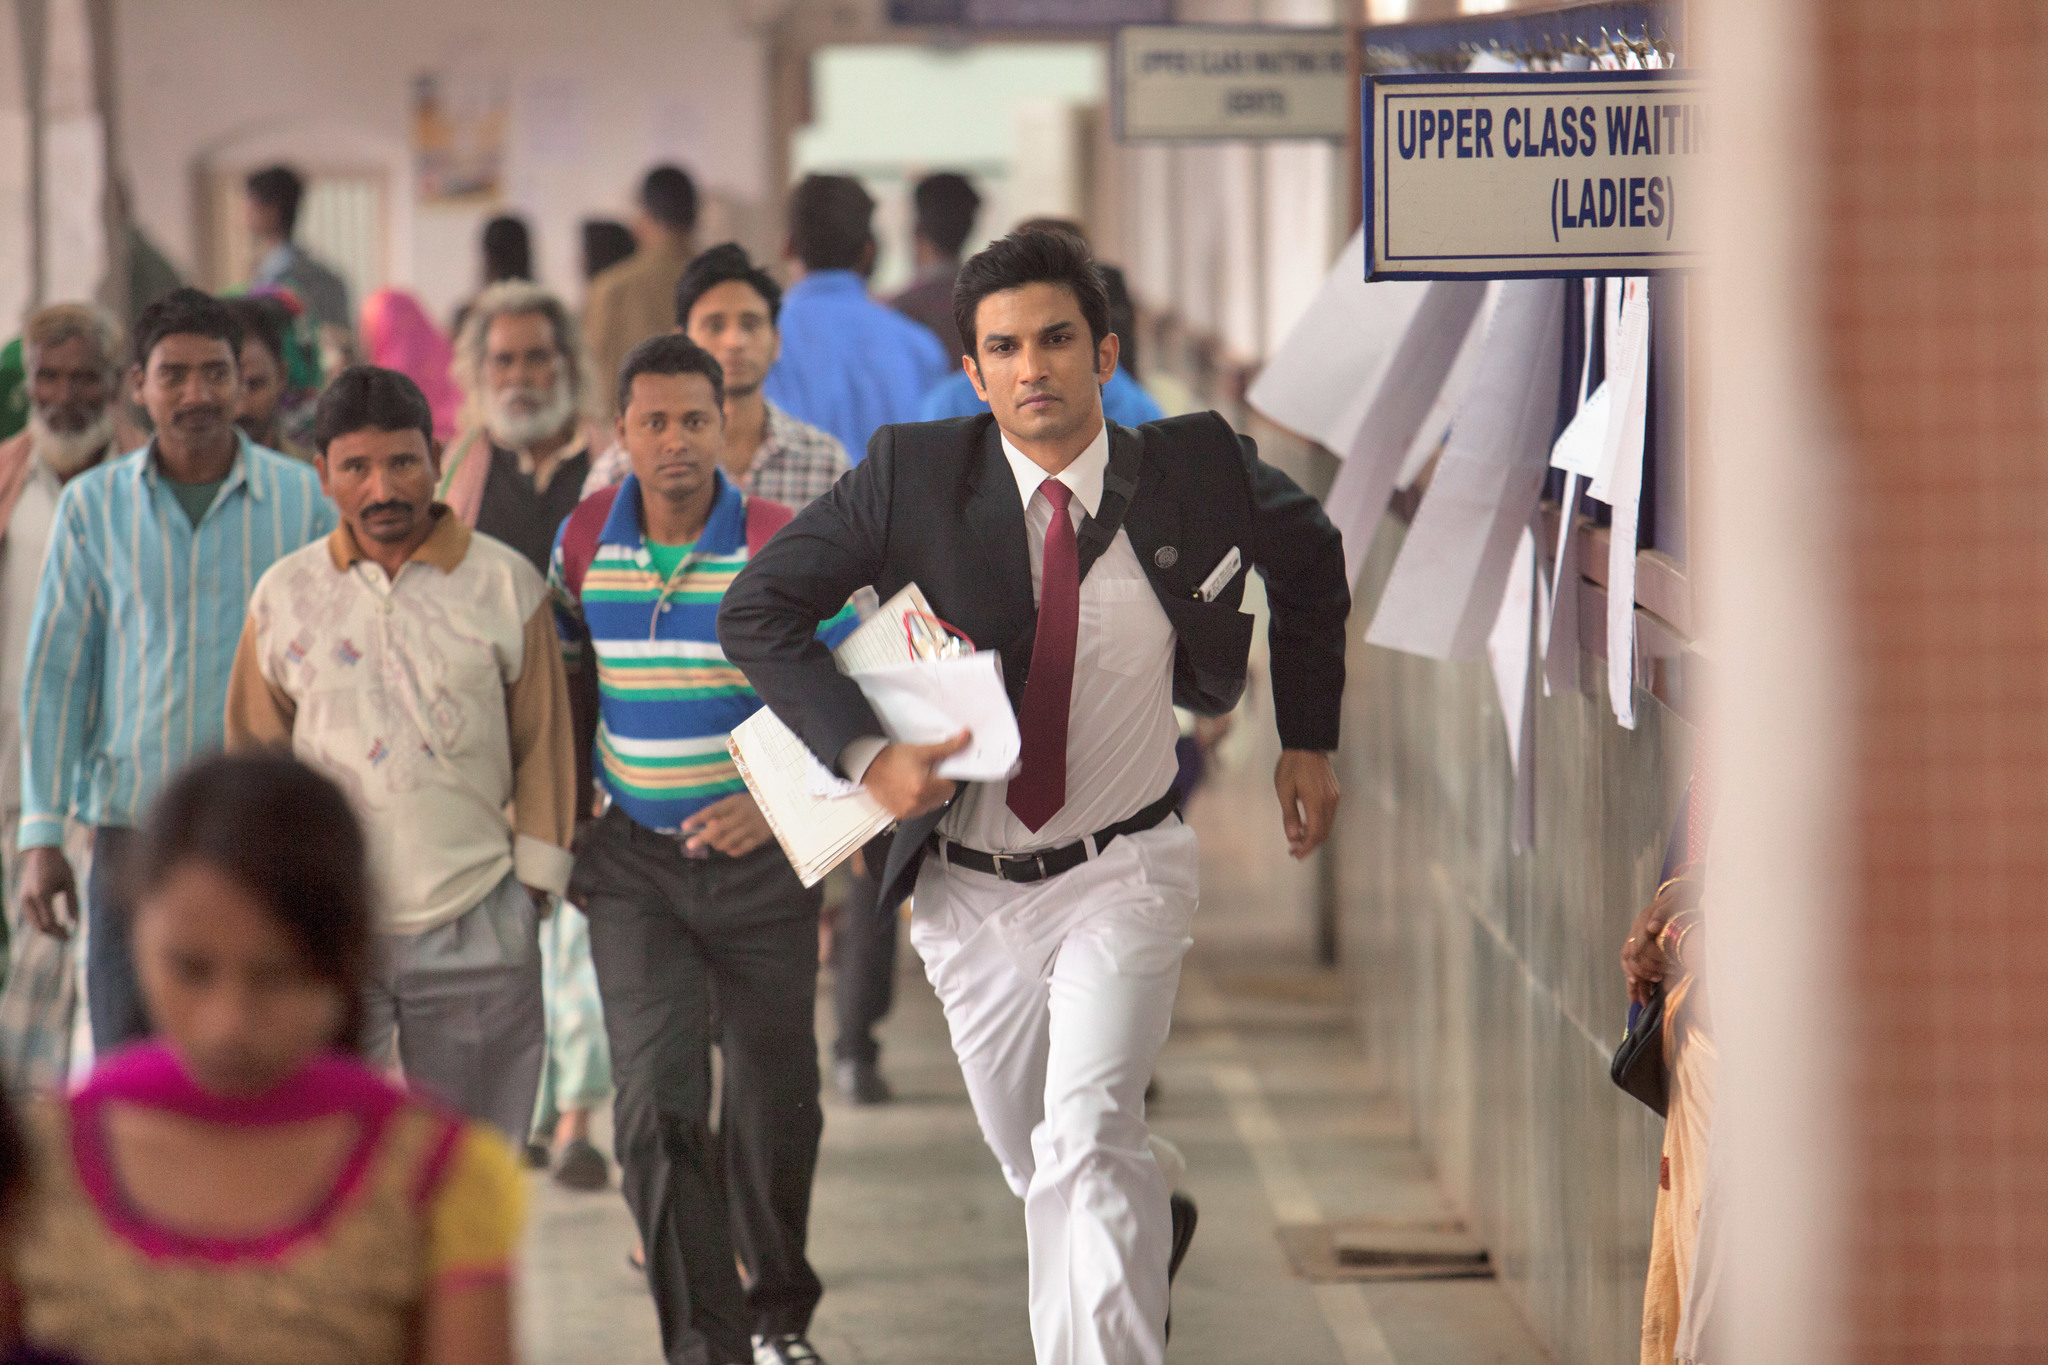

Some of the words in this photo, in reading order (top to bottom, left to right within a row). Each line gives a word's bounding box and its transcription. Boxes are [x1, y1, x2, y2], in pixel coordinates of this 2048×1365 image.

[1398, 108, 1494, 160] UPPER
[1503, 106, 1597, 158] CLASS
[1551, 176, 1675, 243] (LADIES)
